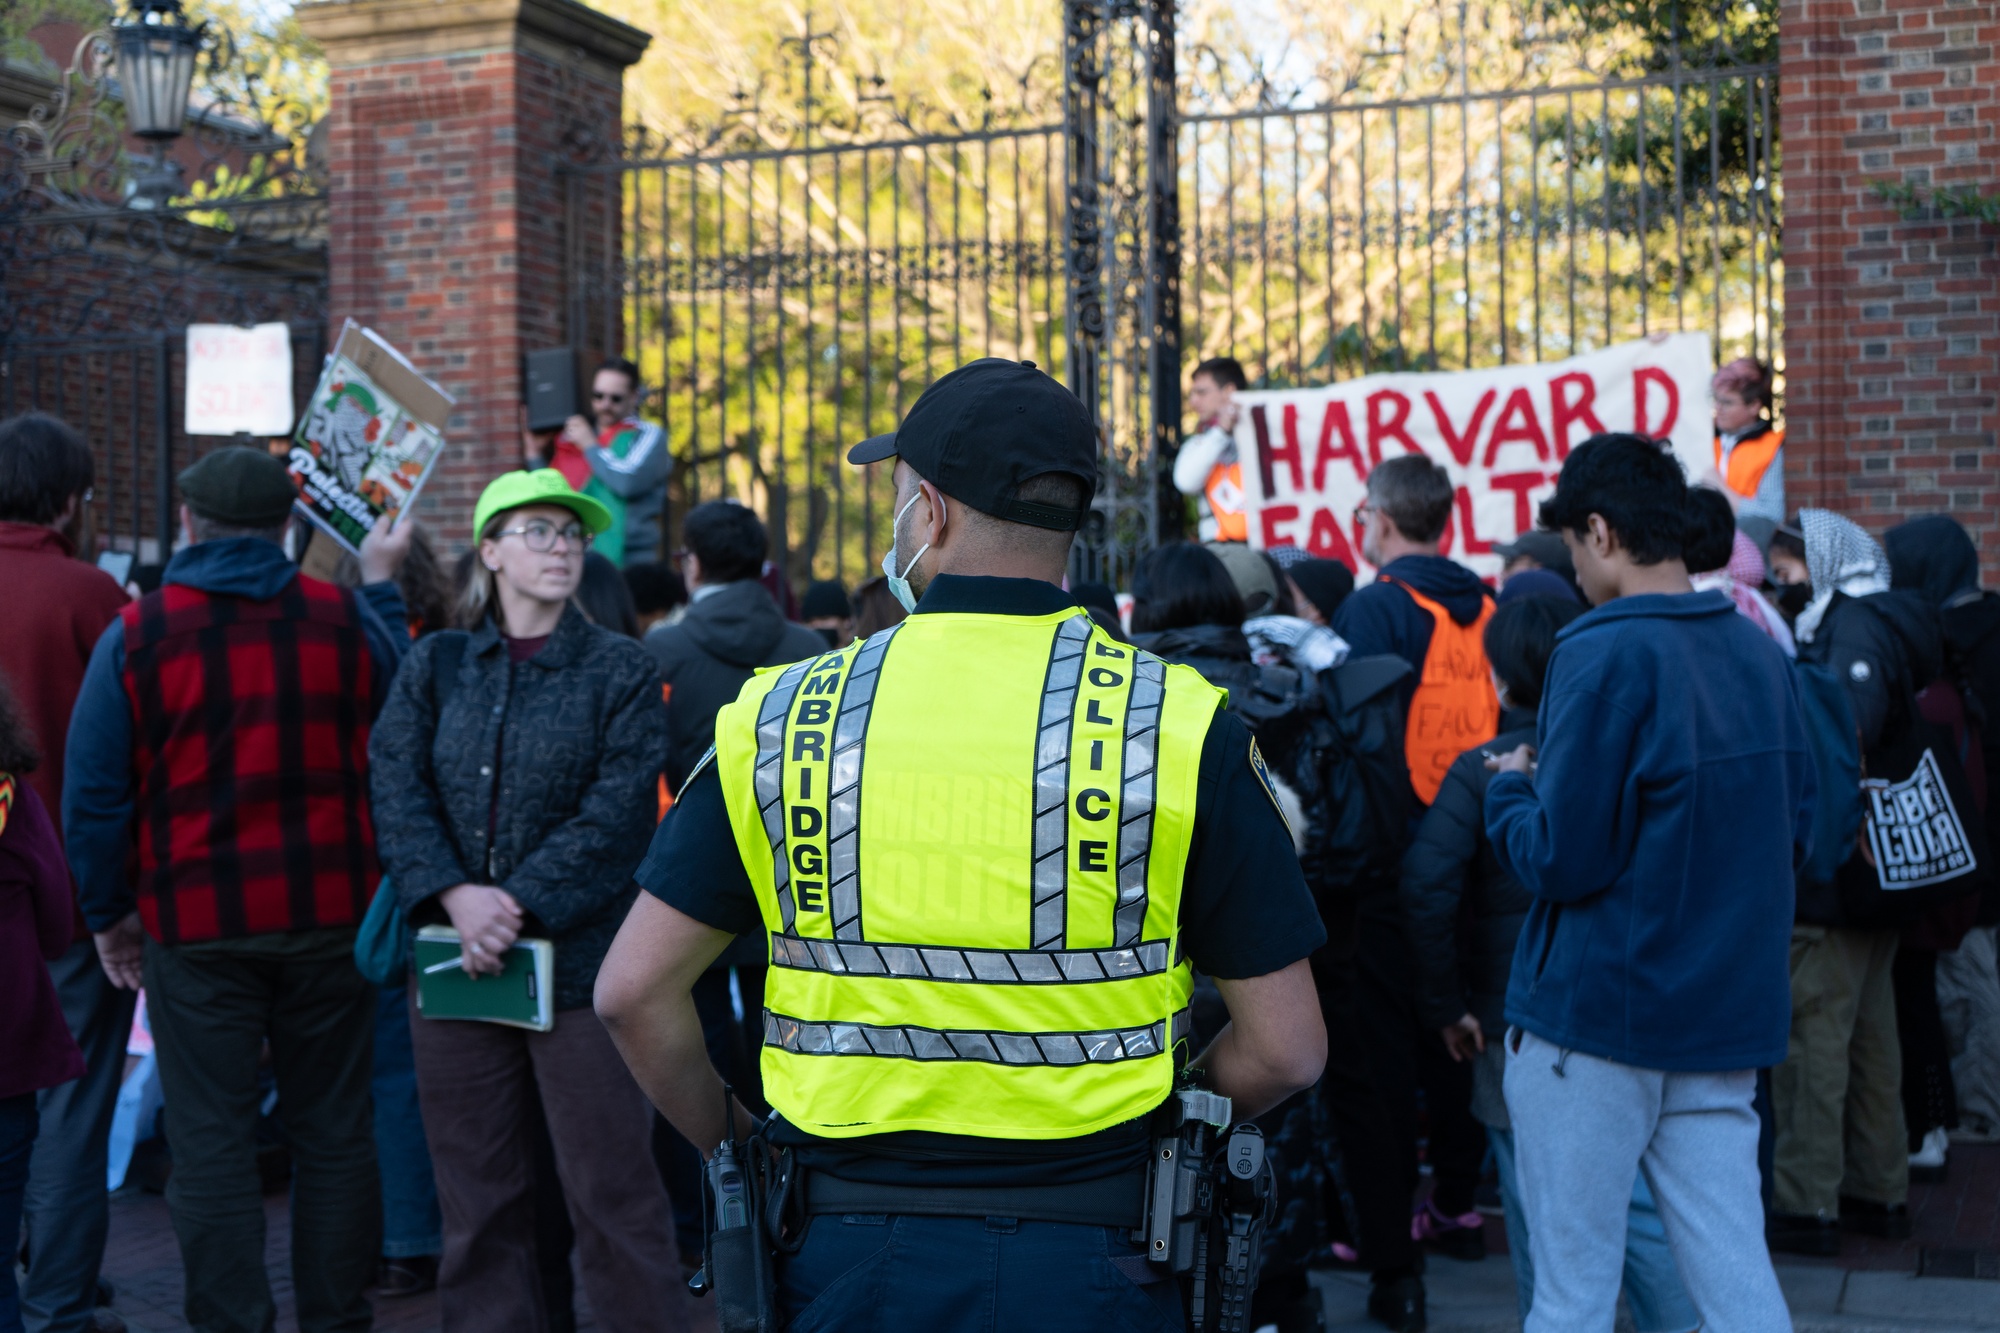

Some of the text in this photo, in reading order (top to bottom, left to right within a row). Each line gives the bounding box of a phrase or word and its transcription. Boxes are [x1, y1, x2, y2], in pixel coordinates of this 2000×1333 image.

[1251, 366, 1680, 499] HARVARD
[288, 447, 376, 532] Palestin
[1260, 470, 1561, 576] FALT
[790, 646, 856, 914] AMBRIDGE
[1076, 641, 1125, 873] POLICE
[1879, 812, 1962, 866] LULA
[1237, 1159, 1252, 1174] SIG
